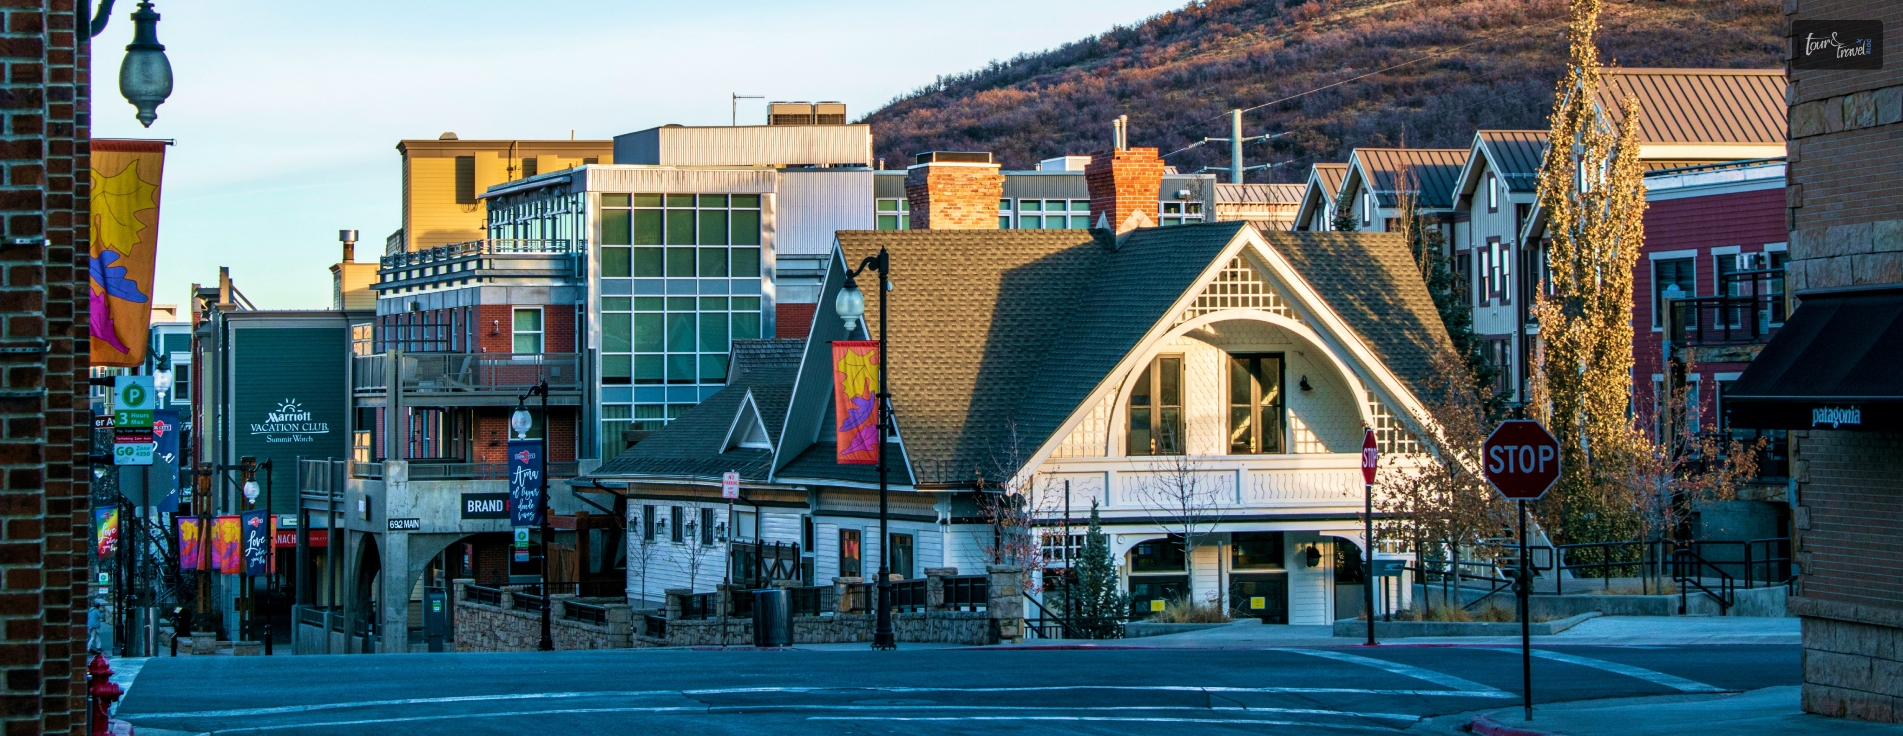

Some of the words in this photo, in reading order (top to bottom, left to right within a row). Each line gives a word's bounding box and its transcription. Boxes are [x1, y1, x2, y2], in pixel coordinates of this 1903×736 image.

[129, 388, 140, 403] P
[119, 412, 128, 425] 3
[265, 411, 311, 423] Marriott
[1812, 405, 1861, 428] patagonia
[250, 423, 299, 431] VACATION
[301, 422, 328, 431] CLUB
[266, 434, 292, 442] Summit
[1363, 447, 1376, 468] STOP
[1489, 445, 1554, 473] STOP
[512, 466, 539, 487] Ama
[467, 500, 503, 512] BRAND
[389, 519, 403, 529] 692
[403, 519, 420, 529] MAIN
[98, 522, 117, 544] Love
[244, 529, 266, 557] Love
